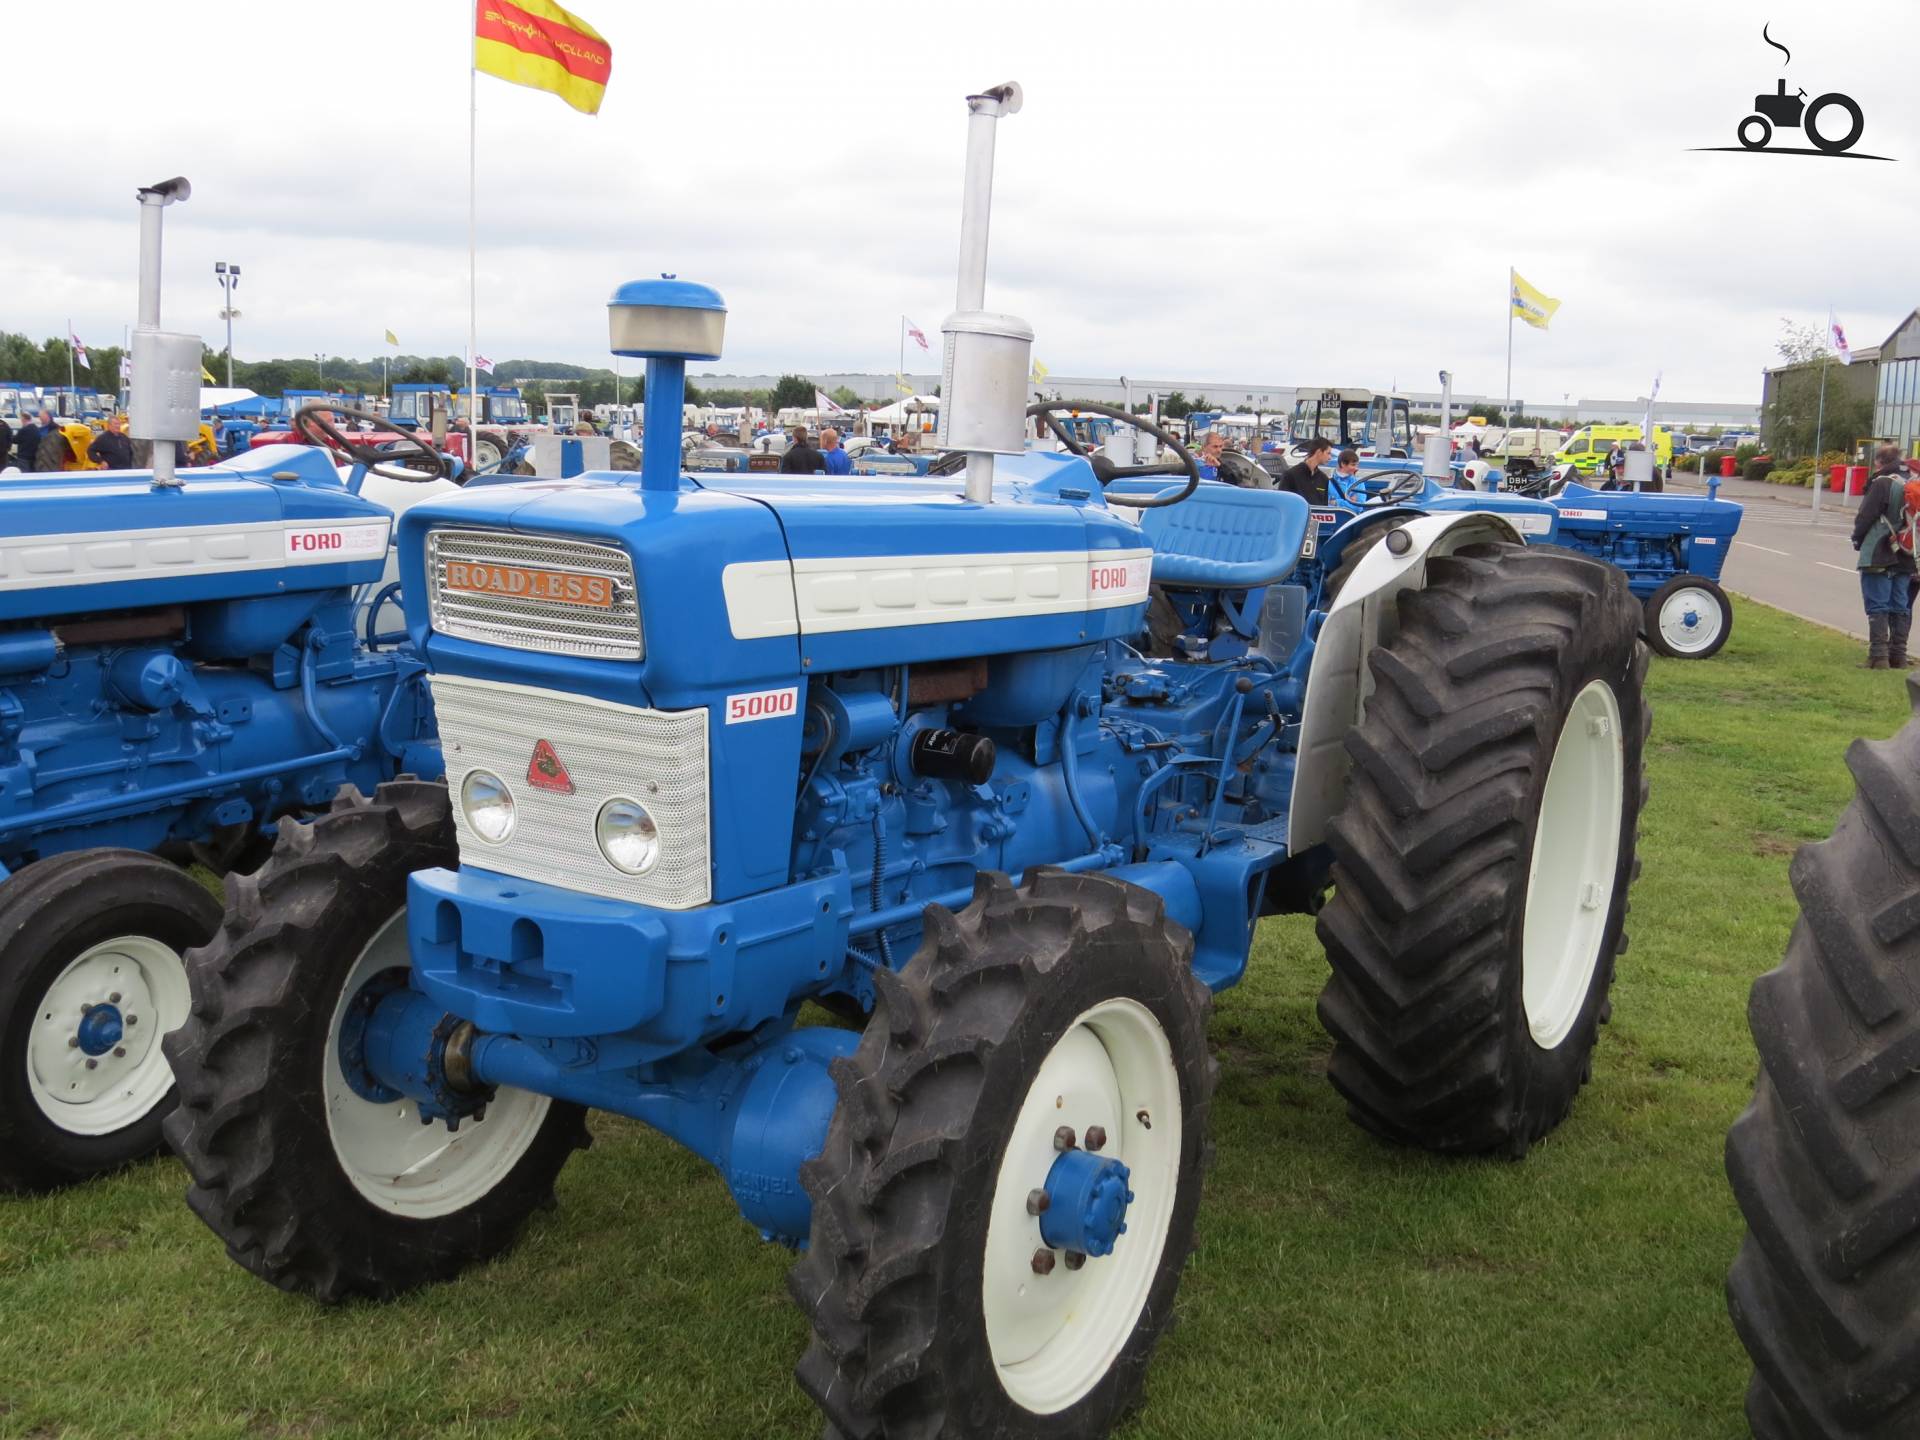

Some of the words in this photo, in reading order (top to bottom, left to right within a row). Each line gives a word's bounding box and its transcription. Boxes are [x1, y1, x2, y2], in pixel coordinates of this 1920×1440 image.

[1509, 477, 1528, 485] DBH
[291, 533, 342, 551] FORD
[450, 565, 605, 603] ROADLESS
[1091, 568, 1127, 590] FORD
[732, 693, 793, 718] 5000
